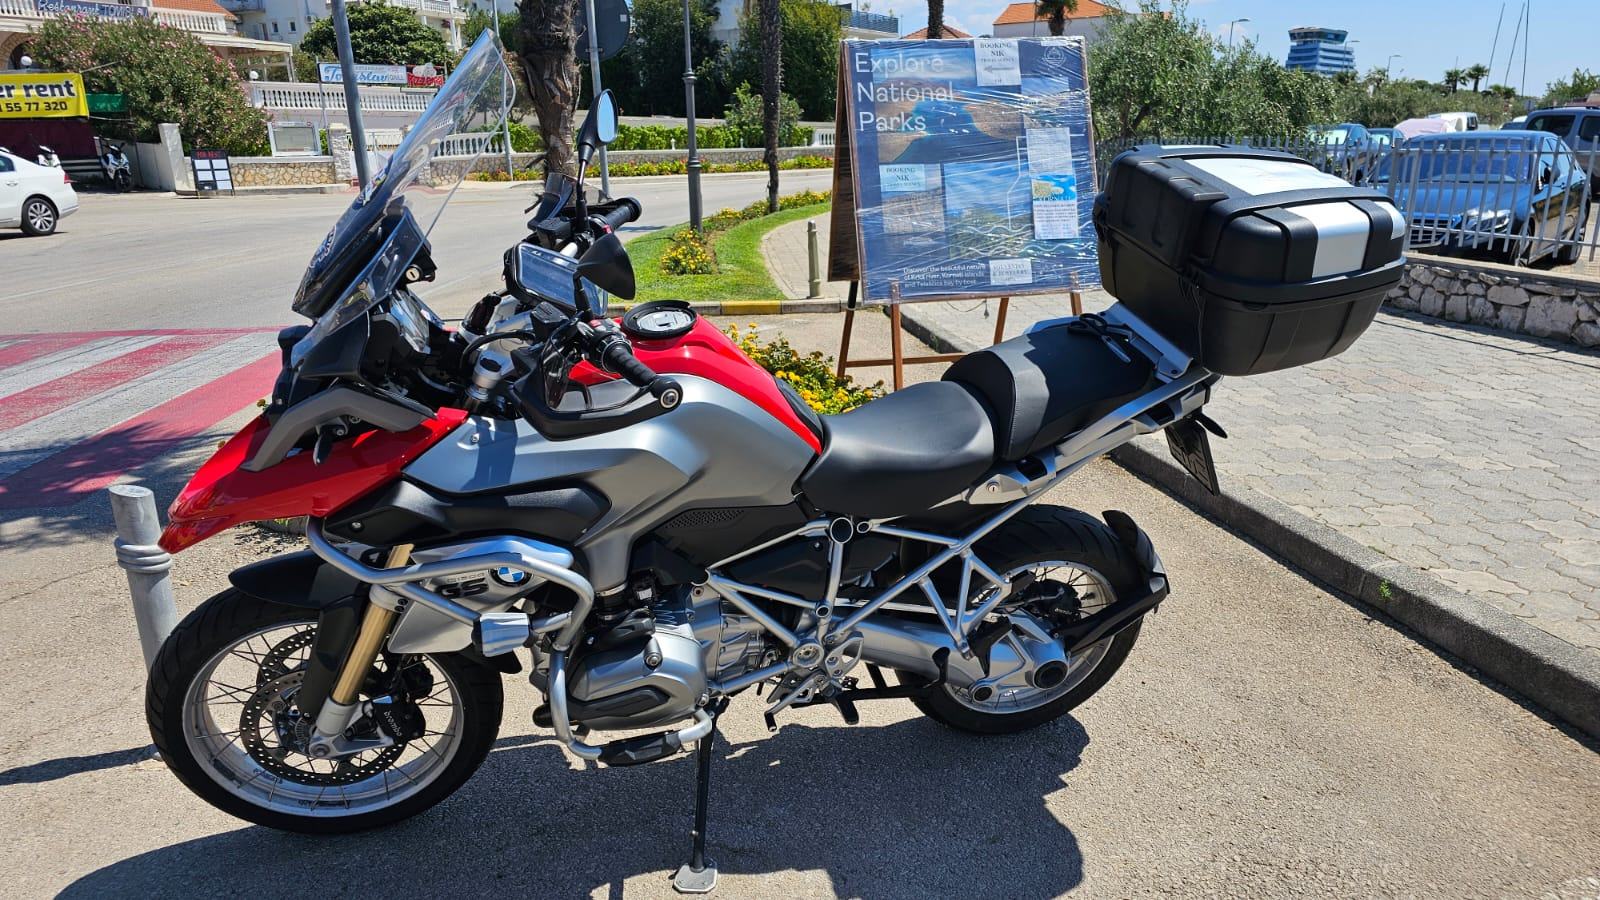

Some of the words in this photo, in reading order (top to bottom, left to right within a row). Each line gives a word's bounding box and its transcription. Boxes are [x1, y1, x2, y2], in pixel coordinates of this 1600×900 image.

[324, 65, 388, 81] Toslav
[855, 53, 944, 78] Explore
[23, 80, 75, 97] rent
[857, 81, 954, 102] National
[5, 102, 22, 112] 55
[25, 102, 39, 111] 77
[44, 101, 68, 111] 320
[859, 111, 926, 131] Parks
